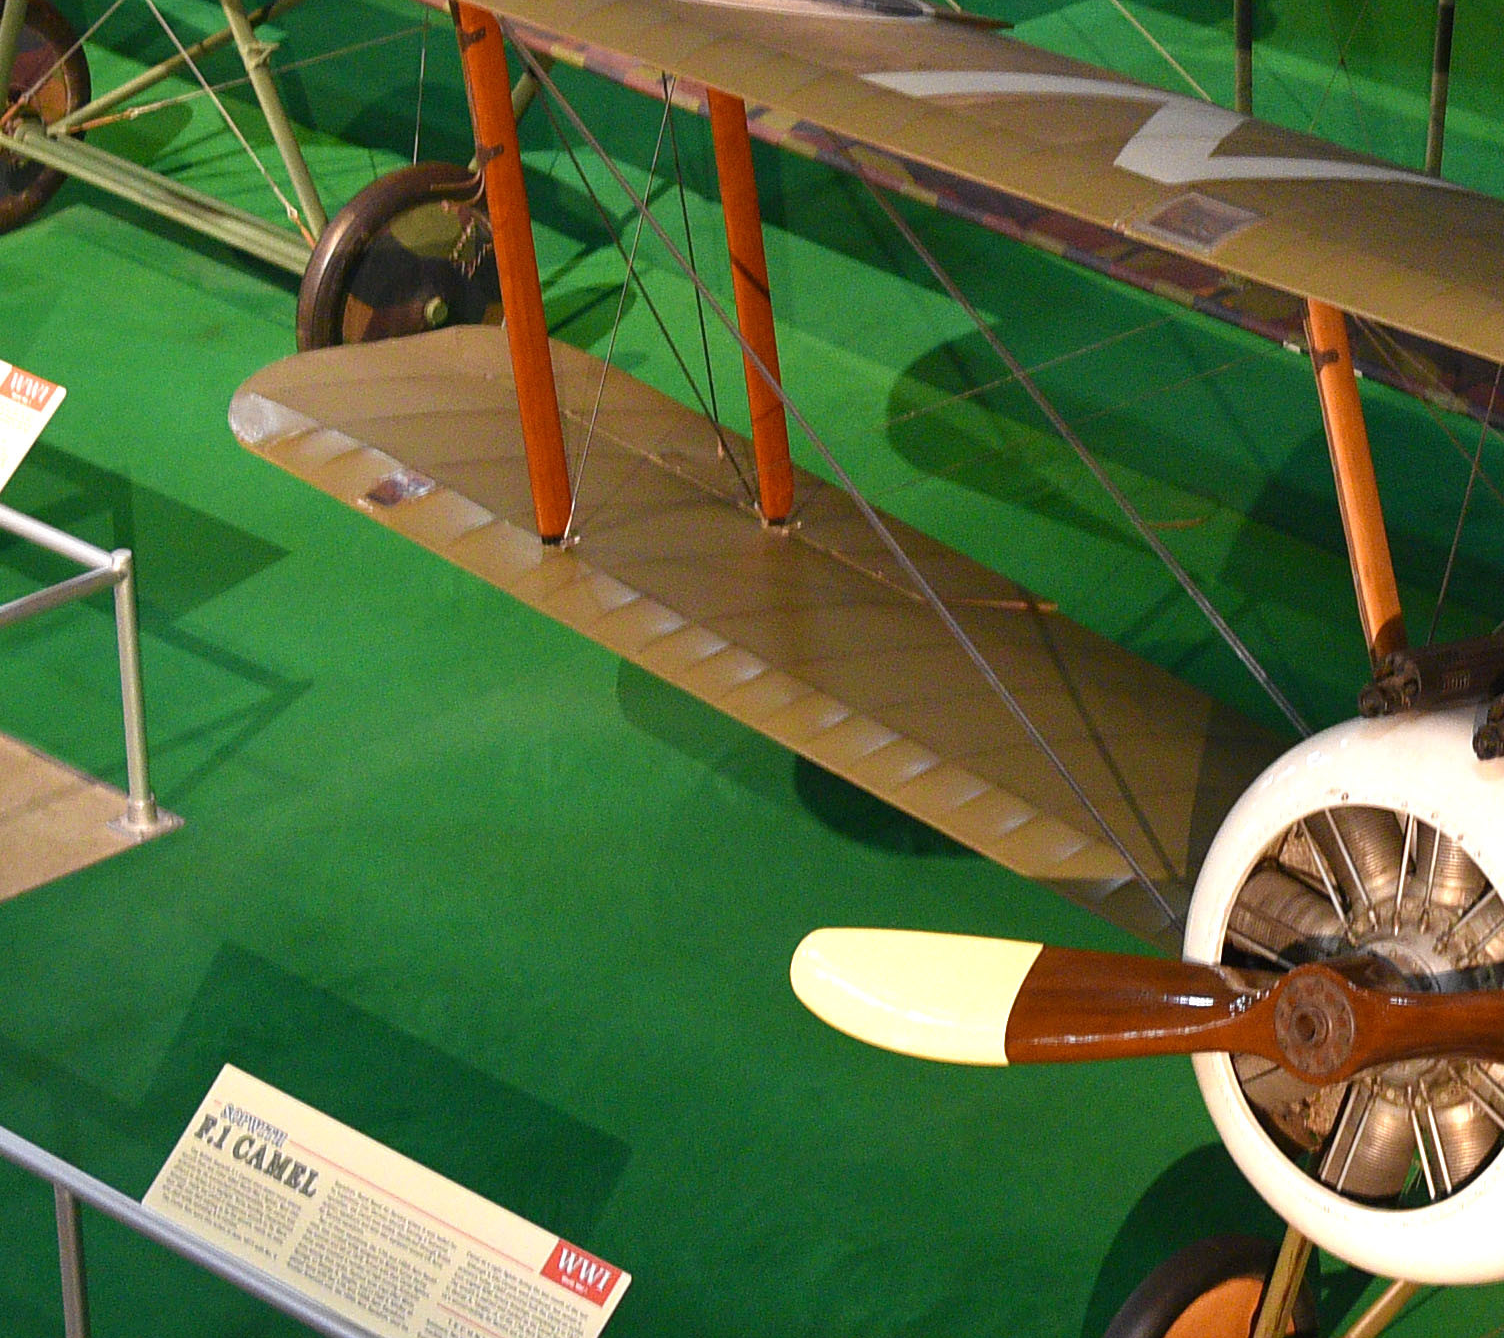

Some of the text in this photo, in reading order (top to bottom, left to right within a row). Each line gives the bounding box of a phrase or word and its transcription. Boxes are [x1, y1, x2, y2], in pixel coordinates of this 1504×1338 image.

[10, 372, 49, 403] WWI
[220, 1103, 289, 1148] SOPWITH
[194, 1113, 320, 1198] F.1 CAMEL
[558, 1247, 612, 1293] WWI
